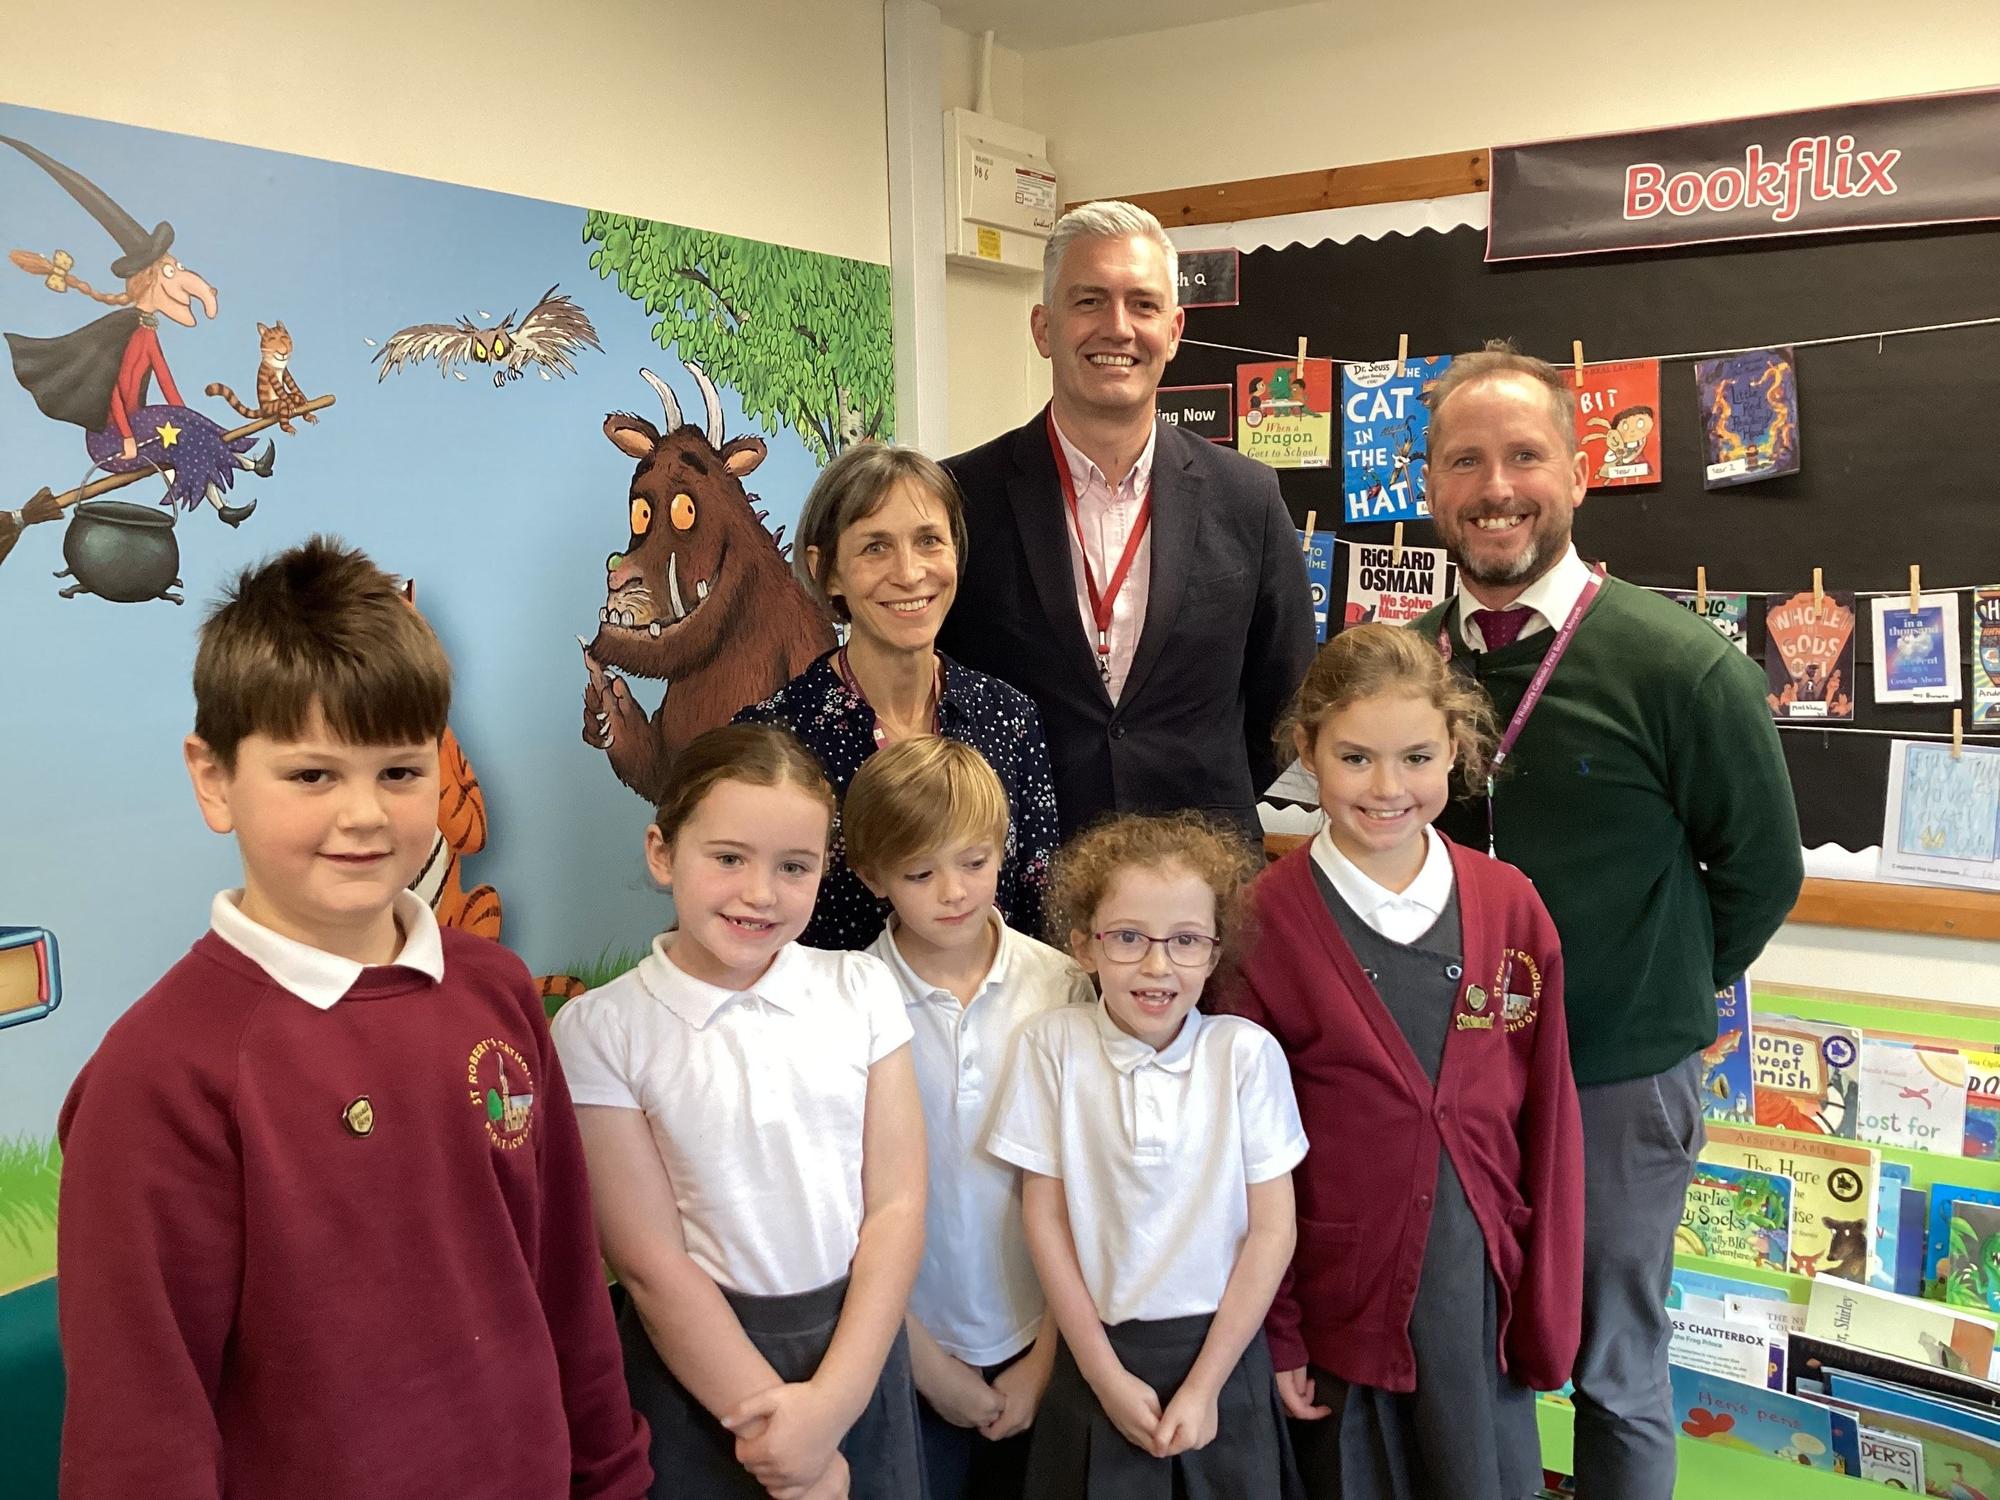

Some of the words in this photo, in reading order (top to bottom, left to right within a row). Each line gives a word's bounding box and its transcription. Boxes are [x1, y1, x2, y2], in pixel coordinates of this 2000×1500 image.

[1623, 134, 1902, 222] Bookflix
[1353, 365, 1366, 375] Dr.
[1369, 361, 1390, 372] Seuss
[1404, 367, 1420, 378] HE
[1184, 408, 1215, 422] Now
[1346, 387, 1413, 423] CAT
[1266, 422, 1291, 432] When
[1354, 428, 1373, 446] IN
[1251, 431, 1312, 446] Dragon
[1272, 449, 1281, 458] to
[1284, 446, 1318, 458] School
[1347, 448, 1387, 468] THE
[1348, 481, 1408, 519] HAT
[1360, 568, 1434, 595] OSMAN
[1380, 593, 1397, 607] We
[1400, 596, 1433, 610] Solve
[1904, 619, 1914, 628] in
[1916, 620, 1923, 628] a
[1782, 634, 1840, 658] GODS
[1504, 1010, 1538, 1033] CHOOL
[1752, 1035, 1804, 1056] ome
[468, 1037, 497, 1084] ROBERT'S
[1753, 1054, 1801, 1071] weet
[1754, 1067, 1811, 1090] mish
[470, 1089, 483, 1105] ST
[1908, 1116, 1941, 1138] for
[1743, 1153, 1772, 1173] The
[1779, 1158, 1821, 1185] Hare
[1688, 1189, 1730, 1206] arlie
[1794, 1187, 1805, 1199] he
[1698, 1205, 1747, 1231] Socks
[1767, 1312, 1788, 1322] THE
[1834, 1295, 1858, 1330] Shirley
[1672, 1320, 1685, 1331] SS
[1689, 1324, 1765, 1347] CHATTERBOX
